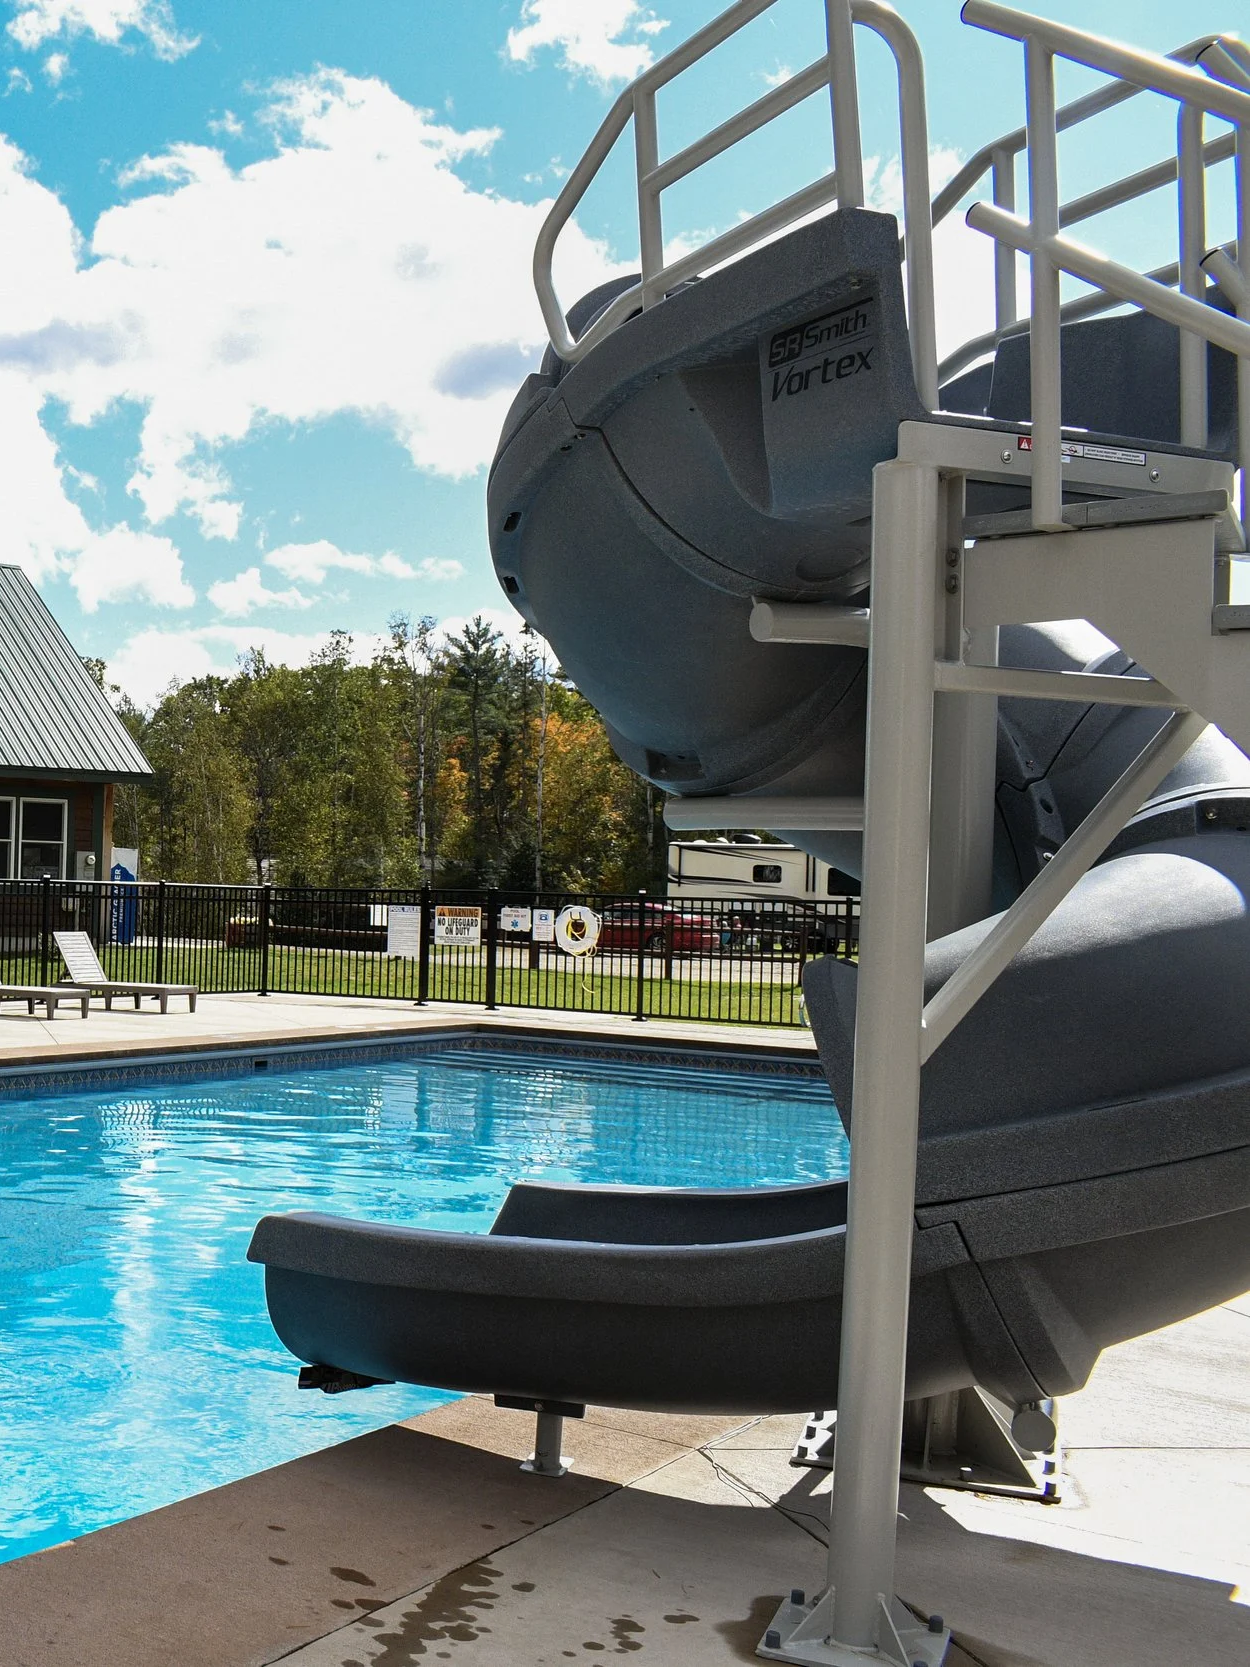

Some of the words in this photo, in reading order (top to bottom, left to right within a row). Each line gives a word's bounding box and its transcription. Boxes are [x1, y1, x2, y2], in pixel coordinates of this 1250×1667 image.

[772, 346, 874, 402] Vortex
[448, 908, 479, 917] WARNING
[437, 917, 446, 927] NO
[447, 917, 479, 928] LIFEGUARD
[444, 927, 454, 936] ON
[455, 927, 471, 936] DUTY
